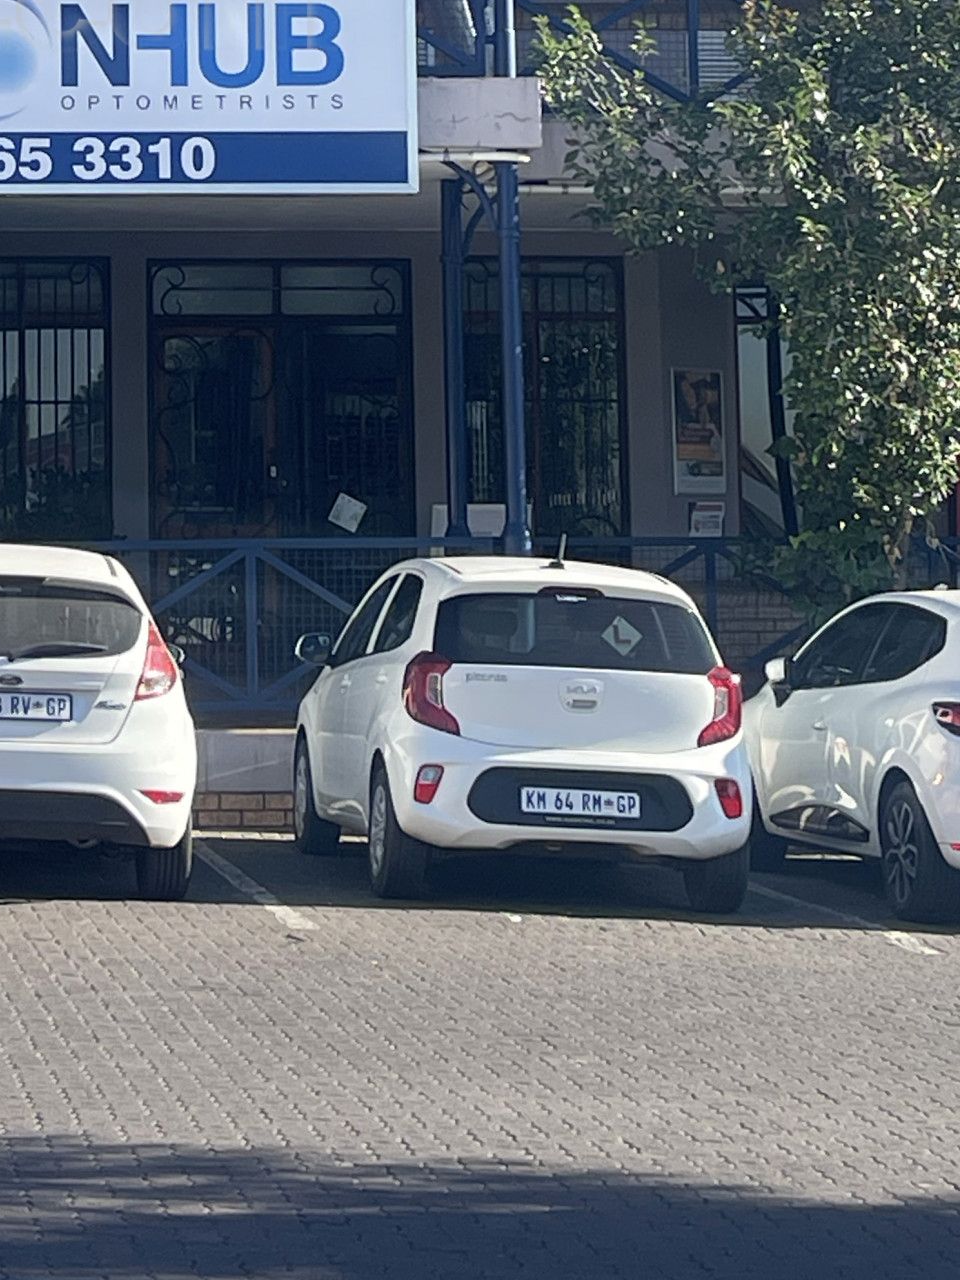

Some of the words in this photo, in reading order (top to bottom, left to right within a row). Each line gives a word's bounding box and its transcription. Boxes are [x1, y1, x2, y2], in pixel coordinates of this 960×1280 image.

[60, 94, 344, 111] OPTOMETRISTS
[71, 137, 216, 181] 3310
[612, 624, 632, 644] L
[10, 695, 32, 715] RV
[46, 698, 67, 717] GP
[525, 790, 547, 809] KM
[554, 792, 574, 811] 64
[581, 793, 602, 813] RM
[616, 795, 637, 815] GP
